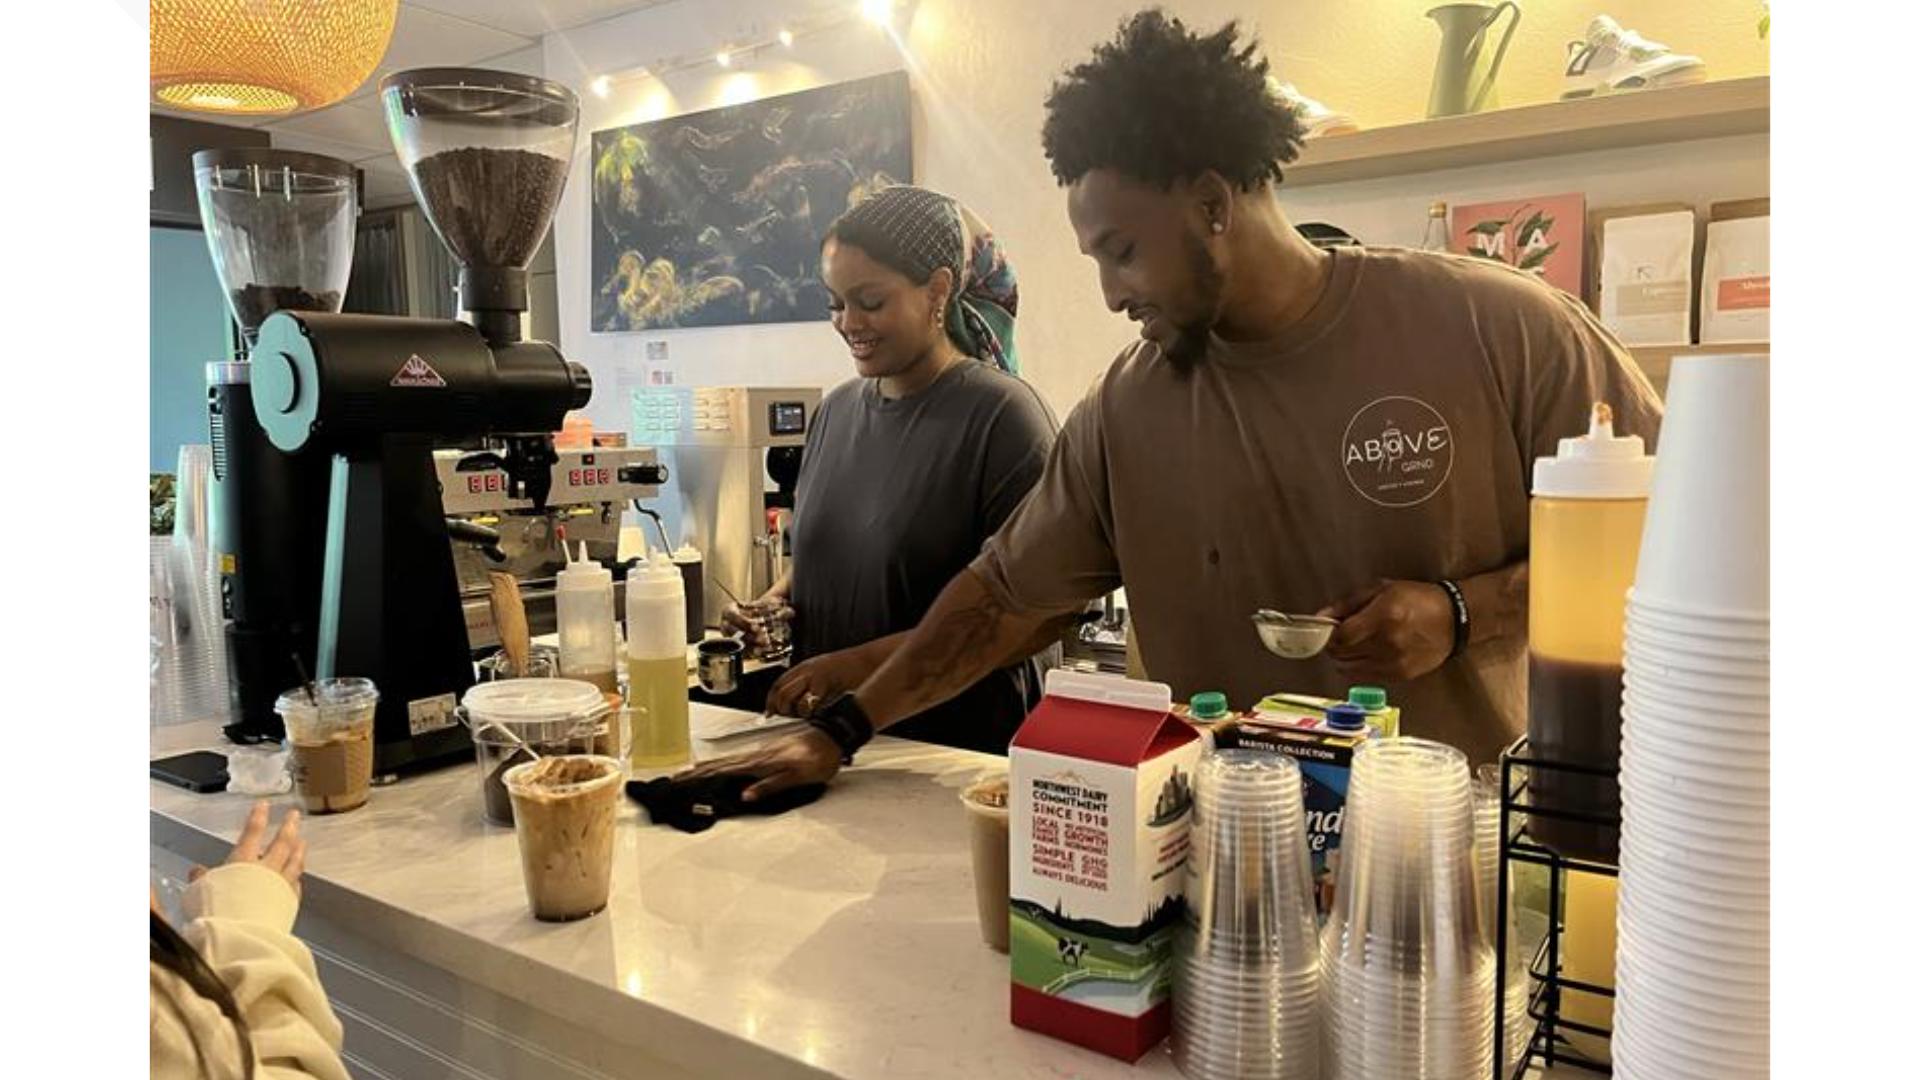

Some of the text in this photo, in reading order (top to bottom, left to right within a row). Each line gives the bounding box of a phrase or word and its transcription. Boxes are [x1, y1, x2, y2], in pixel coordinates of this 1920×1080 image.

[1346, 426, 1448, 465] ABOVE
[1400, 458, 1434, 473] GRND
[1238, 738, 1335, 760] BARISTA COLLECTION
[1032, 779, 1108, 802] NORTHWEST DAIRY
[1032, 790, 1108, 814] COMMITMENT
[1032, 802, 1108, 827] SINCE 1918
[1032, 814, 1059, 829] LOCAL
[1065, 829, 1108, 847] GROWTH
[1032, 844, 1075, 862] SIMPLE
[1065, 874, 1108, 892] DELICIOUS
